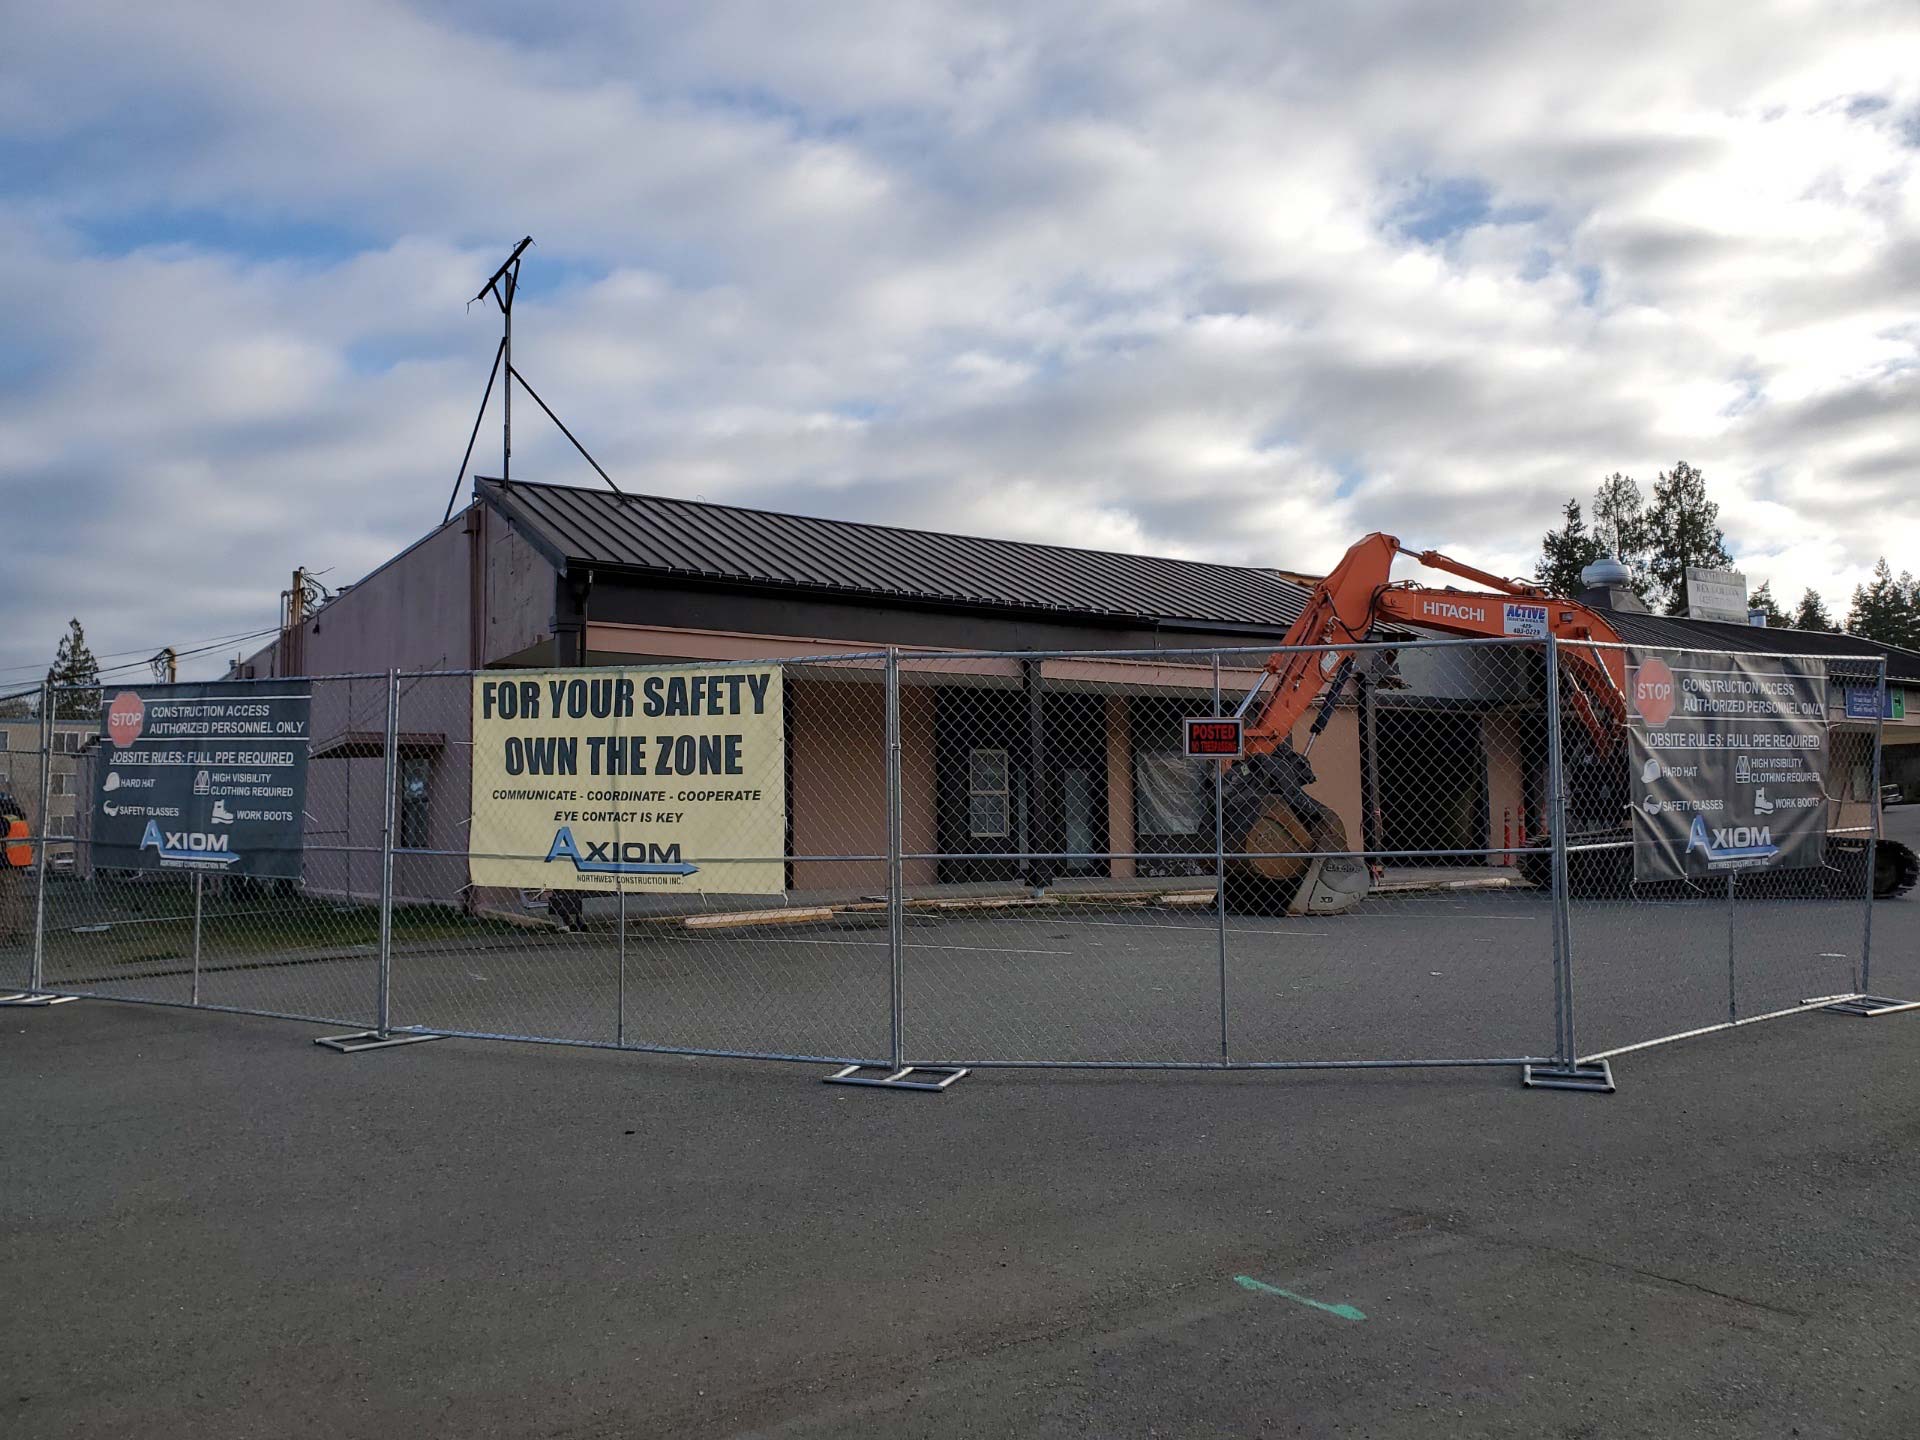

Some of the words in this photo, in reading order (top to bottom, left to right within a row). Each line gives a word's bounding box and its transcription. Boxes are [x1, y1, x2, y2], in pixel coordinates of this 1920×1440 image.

[1423, 601, 1485, 621] HITACHI
[1506, 605, 1546, 619] ACTIVE
[1637, 683, 1671, 700] STOP
[1682, 679, 1759, 694] CONSTRUCTION
[1760, 682, 1795, 696] ACCESS
[482, 681, 541, 720] FOR
[549, 678, 635, 719] YOUR
[642, 673, 771, 717] SAFETY
[151, 705, 224, 718] CONSTRUCTION
[226, 704, 270, 716] ACCESS
[1683, 698, 1745, 713] AUTHORIZED
[1747, 701, 1800, 715] PERSONNEL
[1801, 702, 1825, 715] ONLY
[111, 712, 142, 726] STOP
[149, 722, 209, 734] AUTHORIZED
[211, 722, 273, 734] PERSONNEL
[276, 721, 305, 733] ONLY
[1192, 724, 1236, 740] POSTED
[1645, 732, 1687, 747] JOBSITE
[1688, 733, 1725, 747] RULES:
[1727, 734, 1751, 747] FULL
[1752, 734, 1771, 747] PPE
[1773, 735, 1820, 748] REQUIRED
[109, 752, 150, 764] JOBSITE
[151, 752, 185, 764] RULES:
[187, 752, 212, 764] FULL
[215, 752, 237, 764] PPE
[240, 751, 294, 764] REQUIRED
[504, 736, 578, 776] OWN
[586, 736, 647, 775] THE
[655, 734, 744, 776] ZONE
[1751, 758, 1769, 768] HIGH
[1769, 758, 1803, 769] VISIBILITY
[211, 773, 231, 783] HIGH
[232, 773, 272, 783] VISIBILITY
[1662, 766, 1682, 777] HARD
[1683, 766, 1698, 777] HAT
[1751, 772, 1786, 783] CLOTHING
[1787, 772, 1820, 782] REQUIRED
[120, 778, 141, 788] HARD
[141, 779, 156, 788] HAT
[210, 786, 250, 796] CLOTHING
[252, 787, 293, 797] REQUIRED
[492, 789, 577, 801] COMMUNICATE
[587, 790, 666, 802] COORDINATE
[677, 790, 761, 802] COOPERATE
[1662, 801, 1692, 812] SAFETY
[1693, 800, 1724, 811] GLASSES
[1775, 798, 1796, 808] WORK
[1797, 797, 1819, 808] BOOTS
[119, 806, 145, 816] SAFETY
[146, 806, 180, 817] GLASSES
[236, 810, 262, 821] WORK
[263, 810, 293, 821] BOOTS
[553, 811, 578, 822] EYE
[582, 811, 638, 823] CONTACT
[640, 812, 652, 823] IS
[655, 812, 684, 823] KEY
[140, 819, 229, 852] AXIOM
[1686, 815, 1771, 853] AXIOM
[544, 826, 682, 864] AXIOM
[576, 874, 615, 884] NORTHWEST
[616, 875, 668, 885] CONSTRUCTION
[669, 875, 684, 886] INC.
